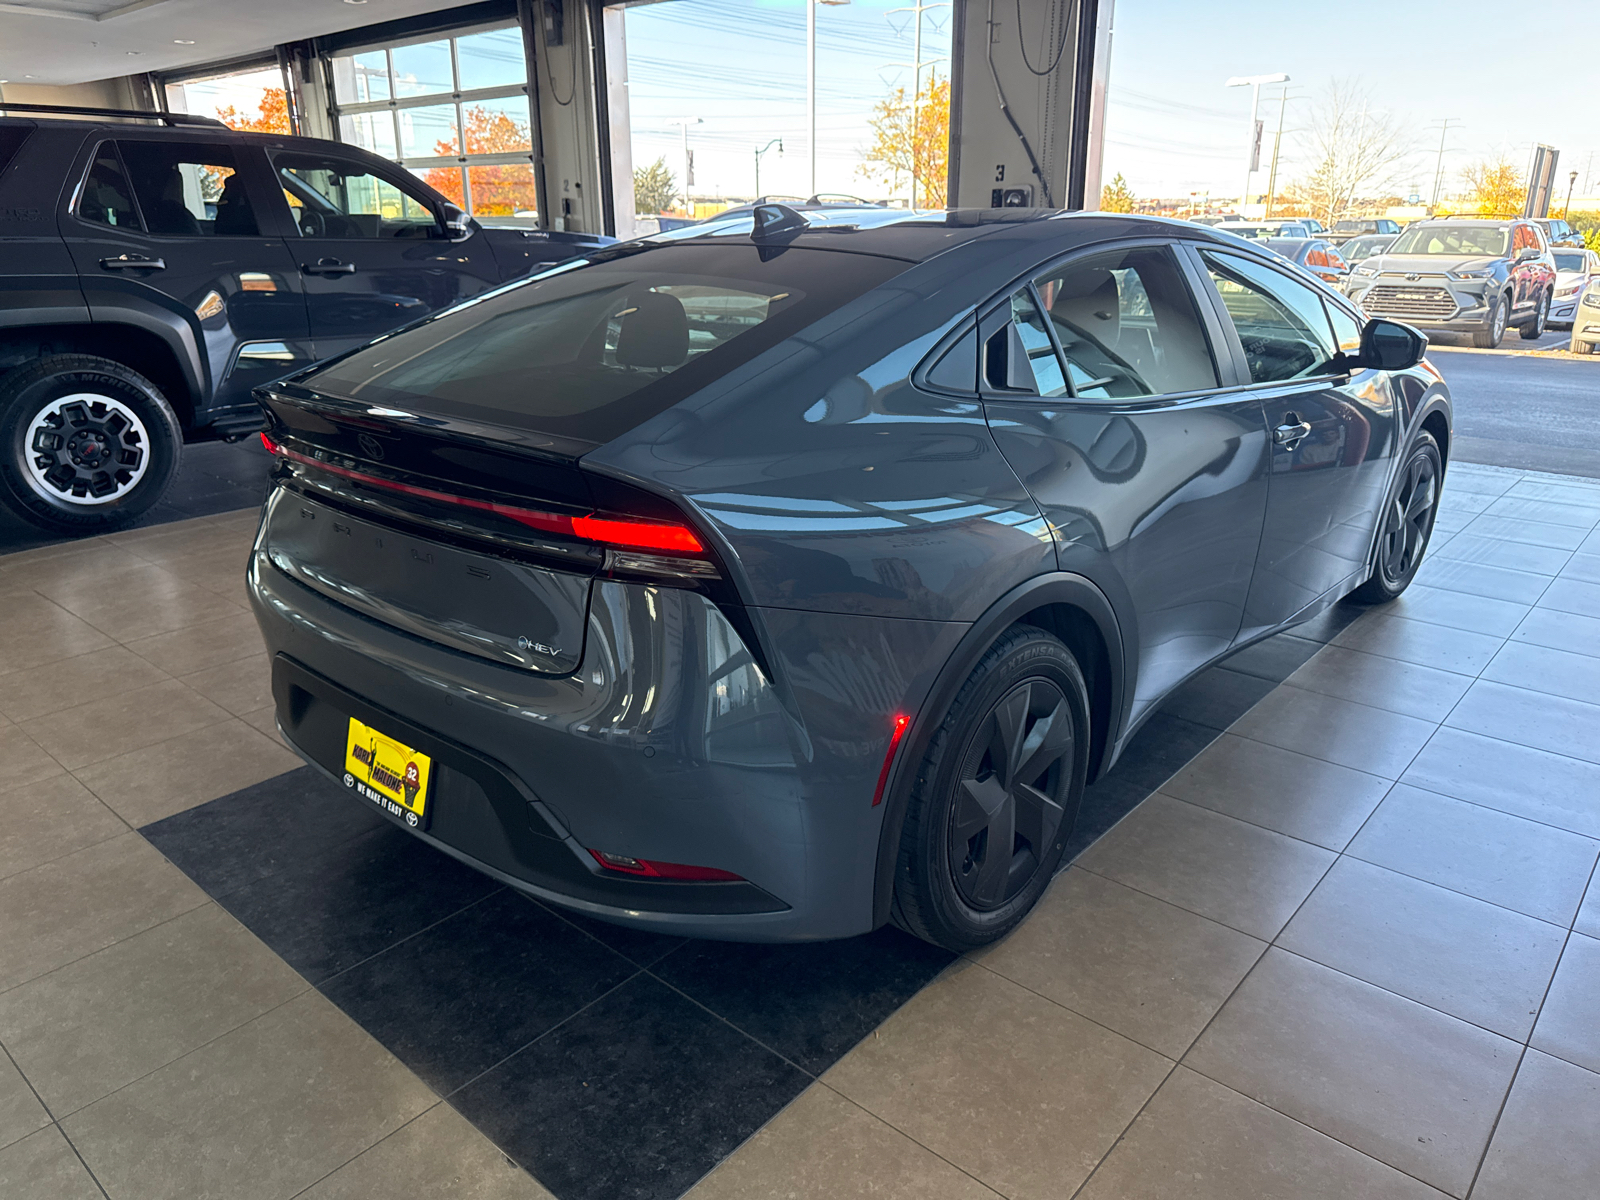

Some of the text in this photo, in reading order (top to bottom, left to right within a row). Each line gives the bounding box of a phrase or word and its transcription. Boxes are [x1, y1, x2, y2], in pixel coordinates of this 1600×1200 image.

[995, 164, 1005, 182] 3
[563, 179, 569, 192] 2
[81, 373, 147, 401] MICHELIN
[527, 640, 562, 656] HEV
[1000, 645, 1055, 677] EXTENSA
[352, 744, 371, 767] KARL
[372, 765, 404, 795] MALONE
[407, 767, 417, 781] 32
[357, 782, 403, 817] WE MAKE IT EASY
